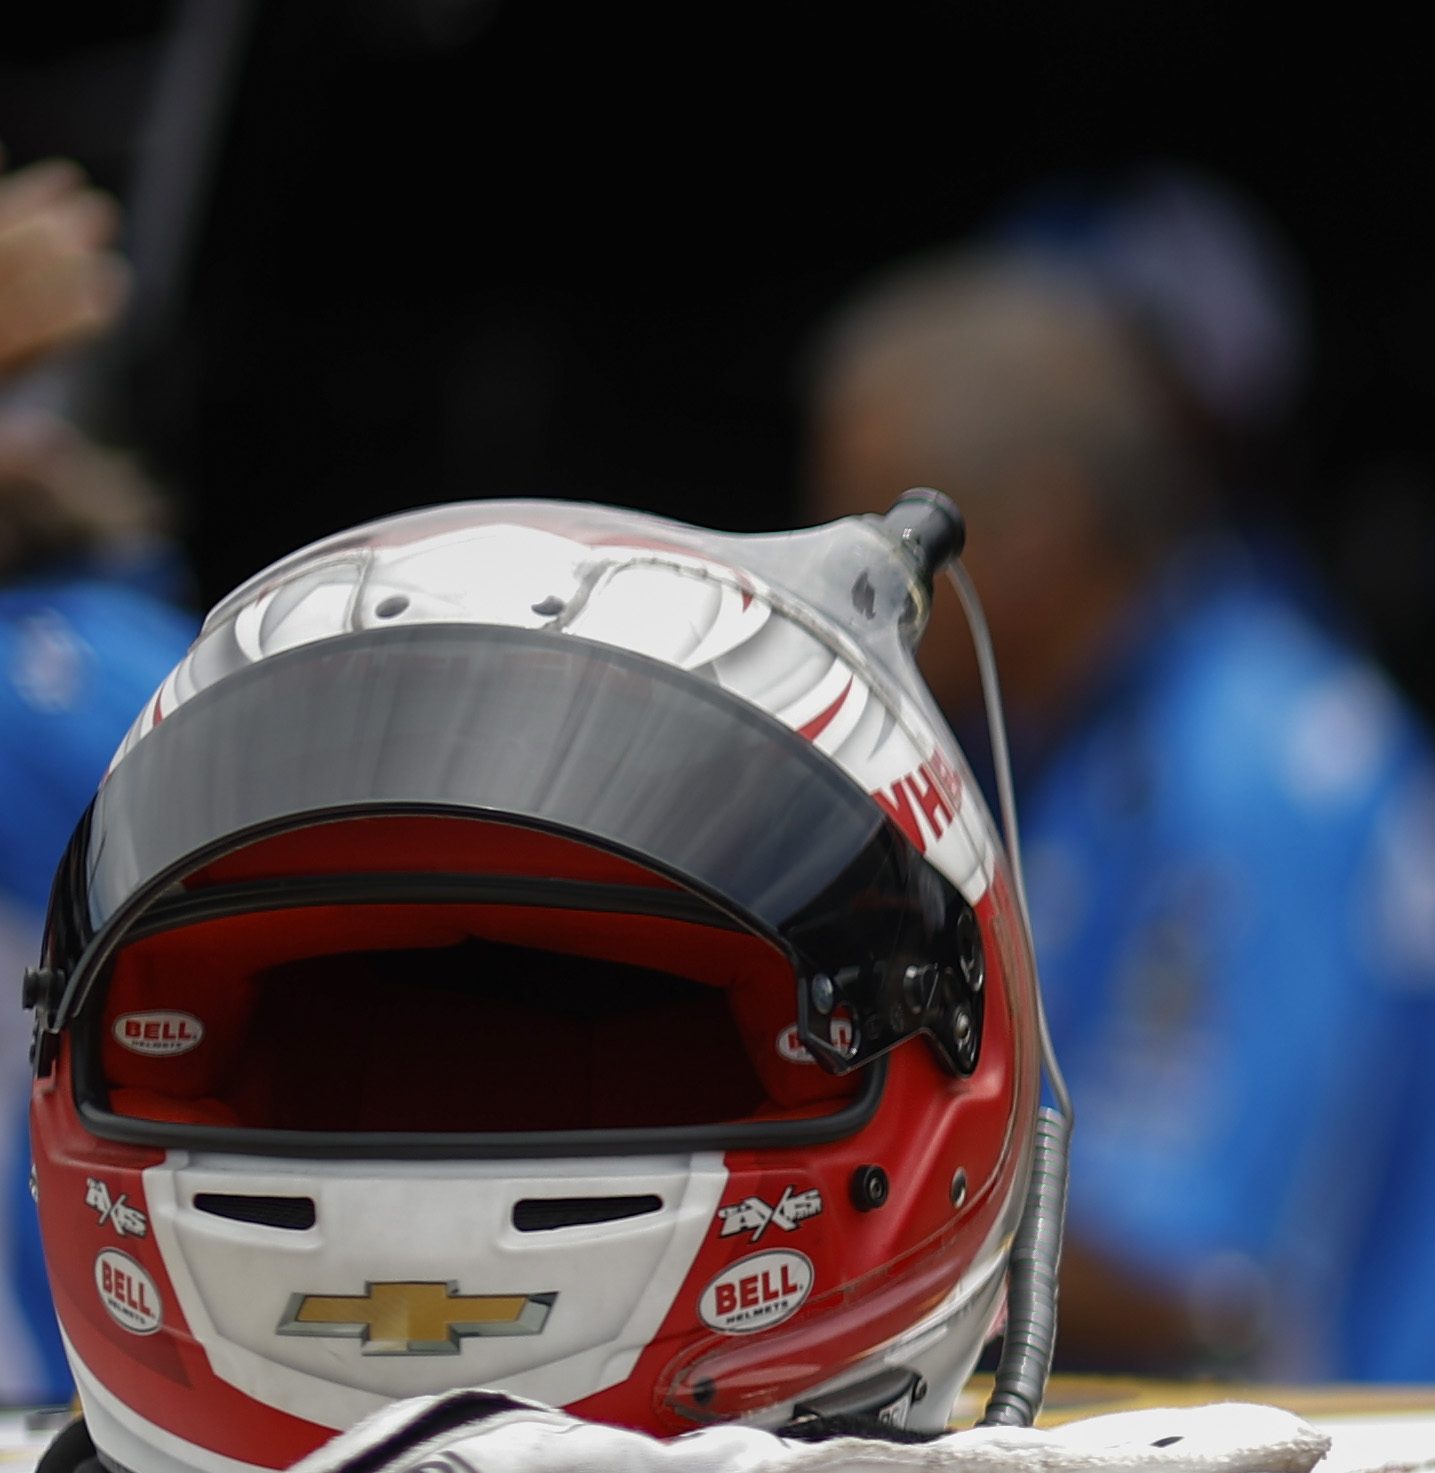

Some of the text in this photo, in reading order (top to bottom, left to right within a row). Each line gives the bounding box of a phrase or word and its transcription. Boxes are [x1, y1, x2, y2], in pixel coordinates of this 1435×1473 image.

[124, 1019, 193, 1040] BELL
[101, 1259, 154, 1319] BELL
[714, 1264, 799, 1318] BELL
[726, 1299, 789, 1325] HELMETS
